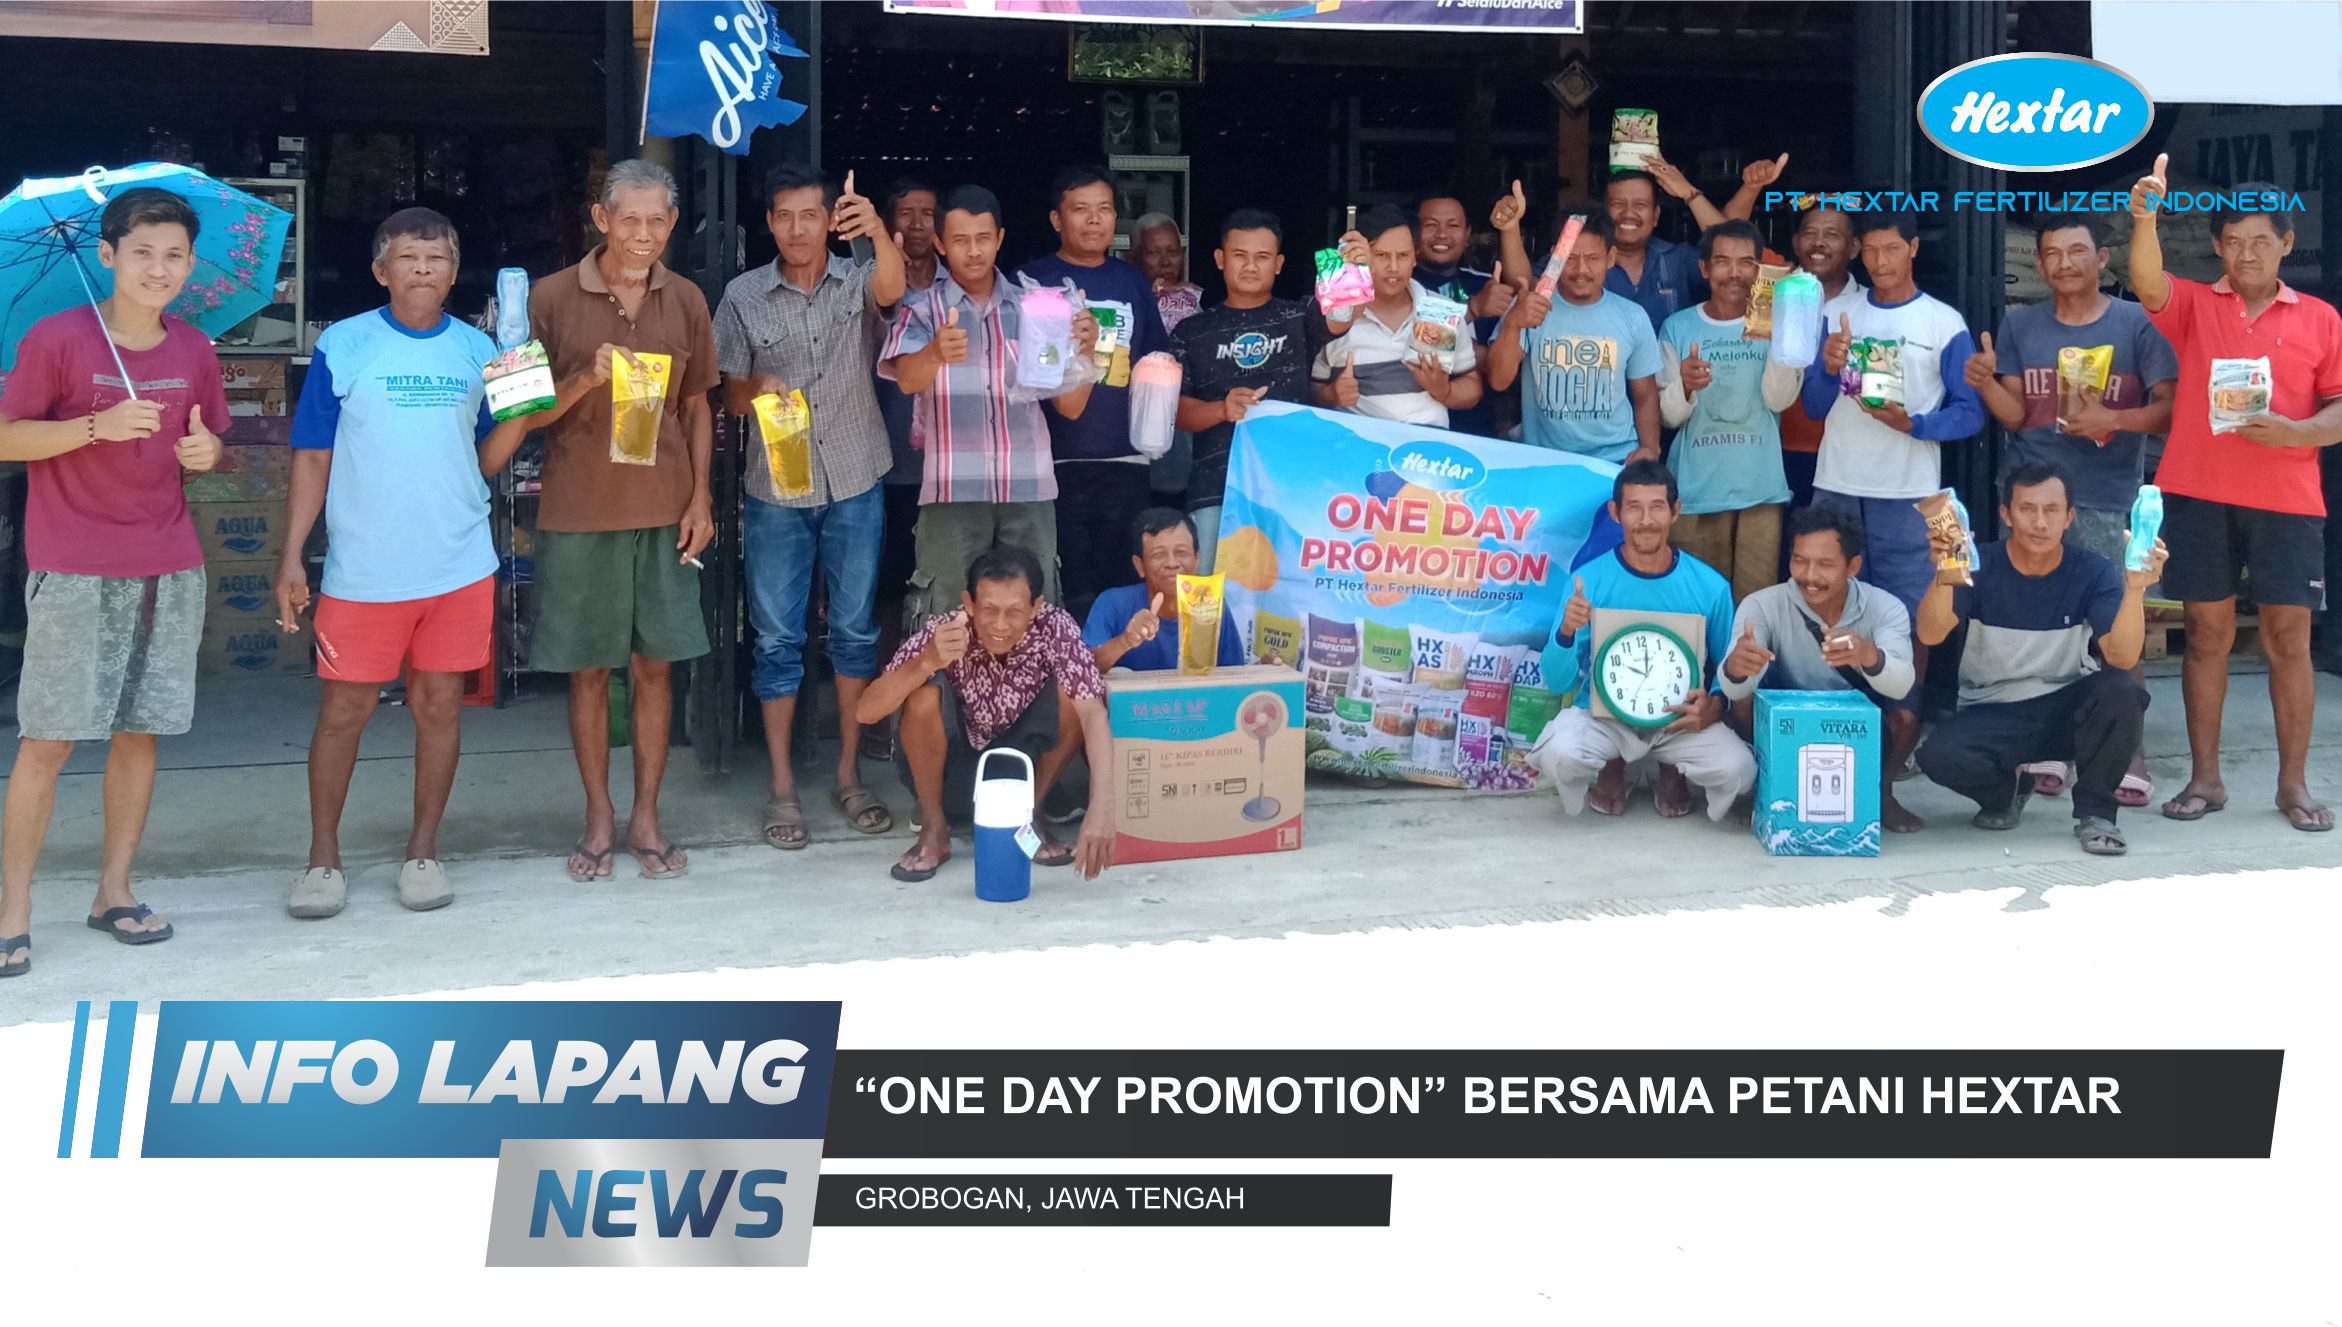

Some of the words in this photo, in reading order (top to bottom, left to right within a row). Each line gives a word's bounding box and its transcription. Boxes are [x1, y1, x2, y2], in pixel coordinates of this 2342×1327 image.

[1216, 335, 1288, 359] INSIGHT
[1538, 338, 1600, 366] the
[1709, 350, 1765, 362] Melonku
[386, 375, 433, 386] MITRA
[436, 375, 469, 389] TANI
[1539, 364, 1612, 412] JOGJA
[1691, 434, 1745, 449] ARAMIS
[1401, 452, 1474, 481] Hextar
[1327, 494, 1430, 536] ONE
[1442, 501, 1539, 542] DAY
[215, 516, 269, 538] AQUA
[1299, 537, 1550, 583] PROMOTION
[217, 574, 271, 596] AQUA
[1314, 577, 1334, 590] PT
[1338, 579, 1384, 593] Hextar
[1388, 582, 1452, 597] Fertilizer
[1456, 587, 1524, 601] Indonesia
[226, 634, 279, 655] AQUA
[1263, 635, 1289, 649] GOLD
[1417, 637, 1444, 653] HX
[1621, 641, 1631, 653] 11
[1636, 636, 1647, 648] 12
[1417, 653, 1442, 668] AS
[1468, 655, 1495, 670] HX
[1610, 654, 1621, 667] 10
[1668, 650, 1675, 662] 2
[1516, 660, 1540, 676] HX
[1675, 666, 1683, 679] 3
[1514, 675, 1541, 686] DAP
[1610, 672, 1616, 684] 9
[1616, 688, 1623, 700] 8
[1673, 683, 1680, 696] 4
[1630, 699, 1637, 712] 7
[1647, 702, 1654, 715] 6
[1821, 723, 1868, 734] VITARA
[1176, 750, 1202, 760] KIPAS
[1205, 747, 1243, 757] BERDIRI
